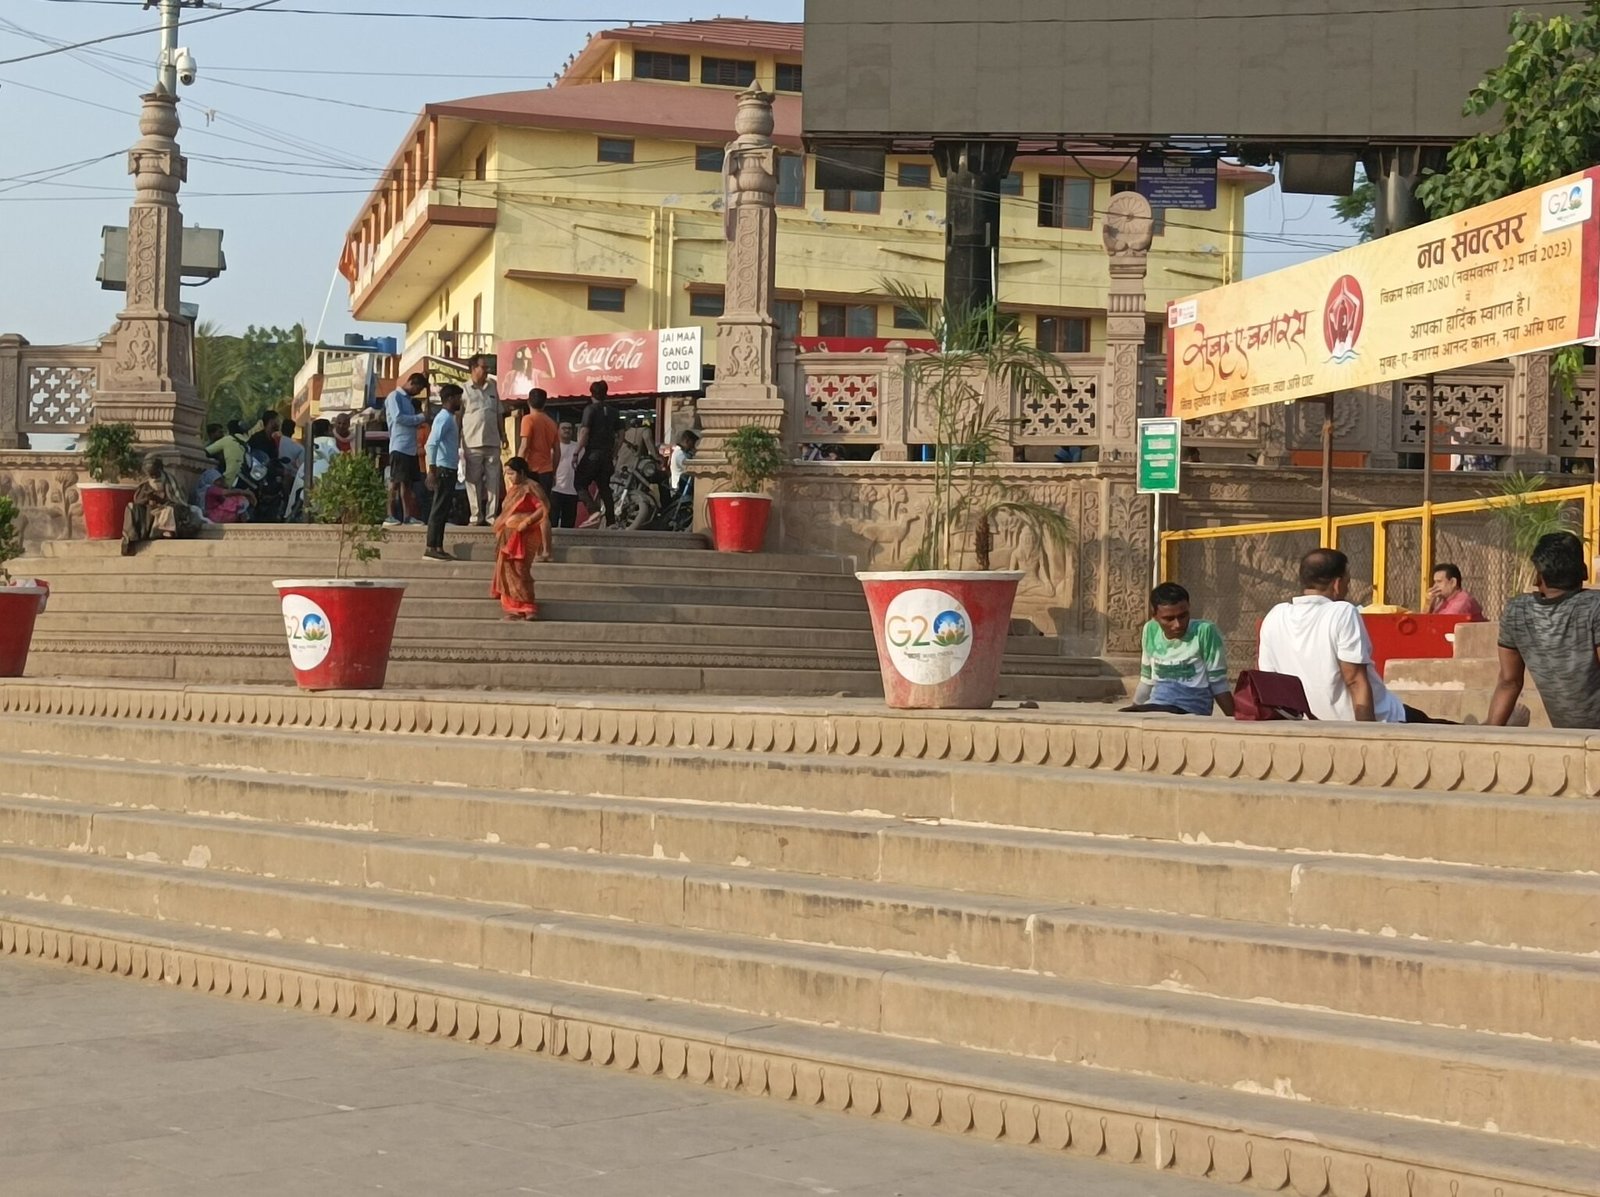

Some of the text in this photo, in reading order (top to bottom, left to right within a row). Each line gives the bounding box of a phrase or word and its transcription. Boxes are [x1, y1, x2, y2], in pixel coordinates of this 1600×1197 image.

[1548, 186, 1582, 215] G20
[1417, 212, 1528, 269] नव संवत्सर
[1380, 288, 1403, 305] विक्रम
[1427, 274, 1449, 293] 2080
[1502, 258, 1515, 273] 22
[1518, 244, 1537, 266] मार्च
[1540, 238, 1572, 262] 2023)
[661, 331, 696, 343] JAI MAA
[1410, 318, 1443, 339] आपका
[1480, 300, 1512, 323] स्वागत
[1442, 340, 1468, 356] आनन्द
[1503, 326, 1520, 342] नया
[1523, 317, 1544, 337] असि
[1547, 315, 1567, 332] घाट
[568, 337, 647, 373] Coca-Cola
[662, 346, 694, 357] GANGA
[666, 361, 690, 371] COLD
[664, 375, 691, 385] DRINK
[887, 610, 970, 647] G20
